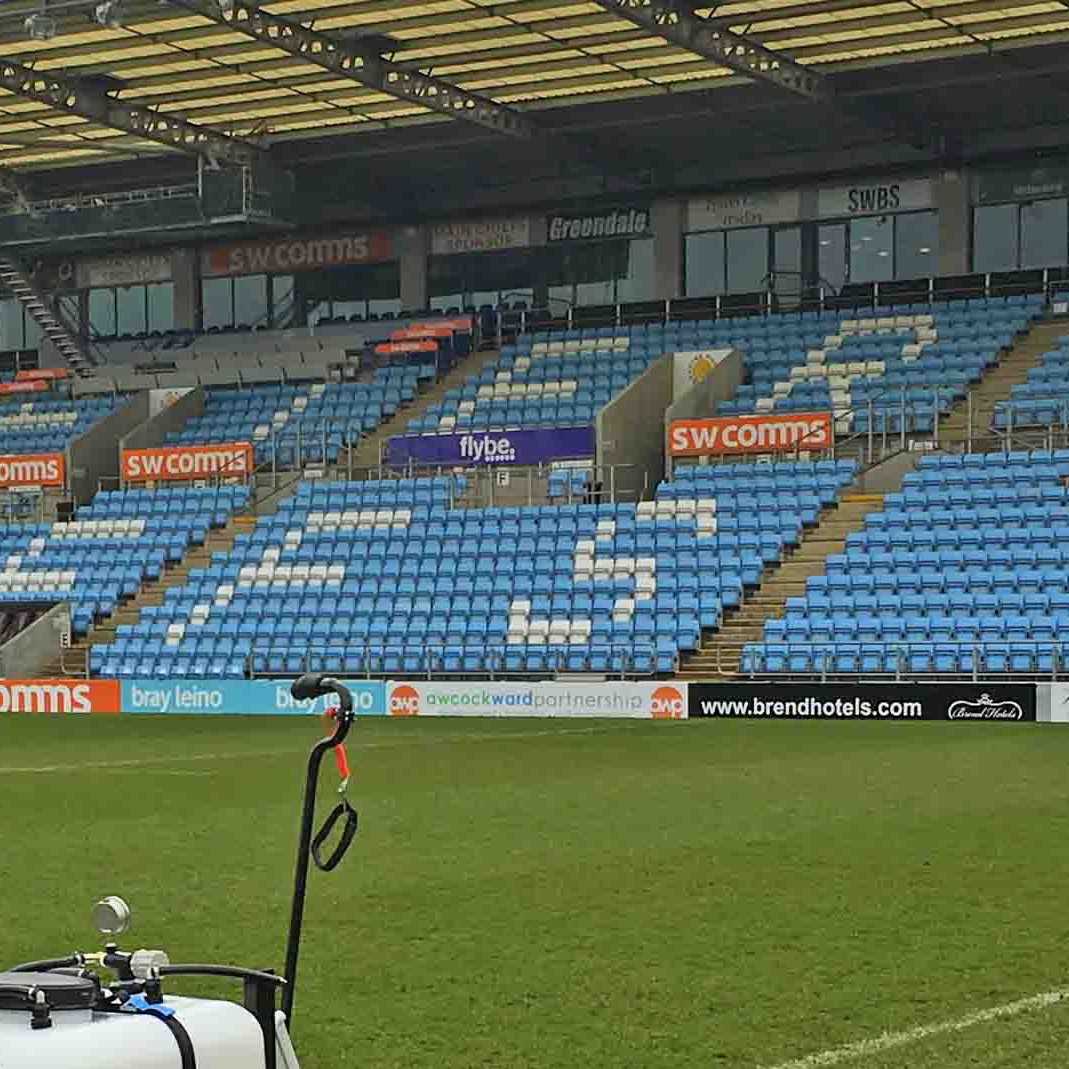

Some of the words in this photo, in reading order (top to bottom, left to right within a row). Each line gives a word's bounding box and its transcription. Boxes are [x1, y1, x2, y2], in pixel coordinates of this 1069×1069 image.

[132, 686, 170, 712] bray
[175, 686, 222, 709] leino
[701, 697, 922, 717] www.brendhotels.com
